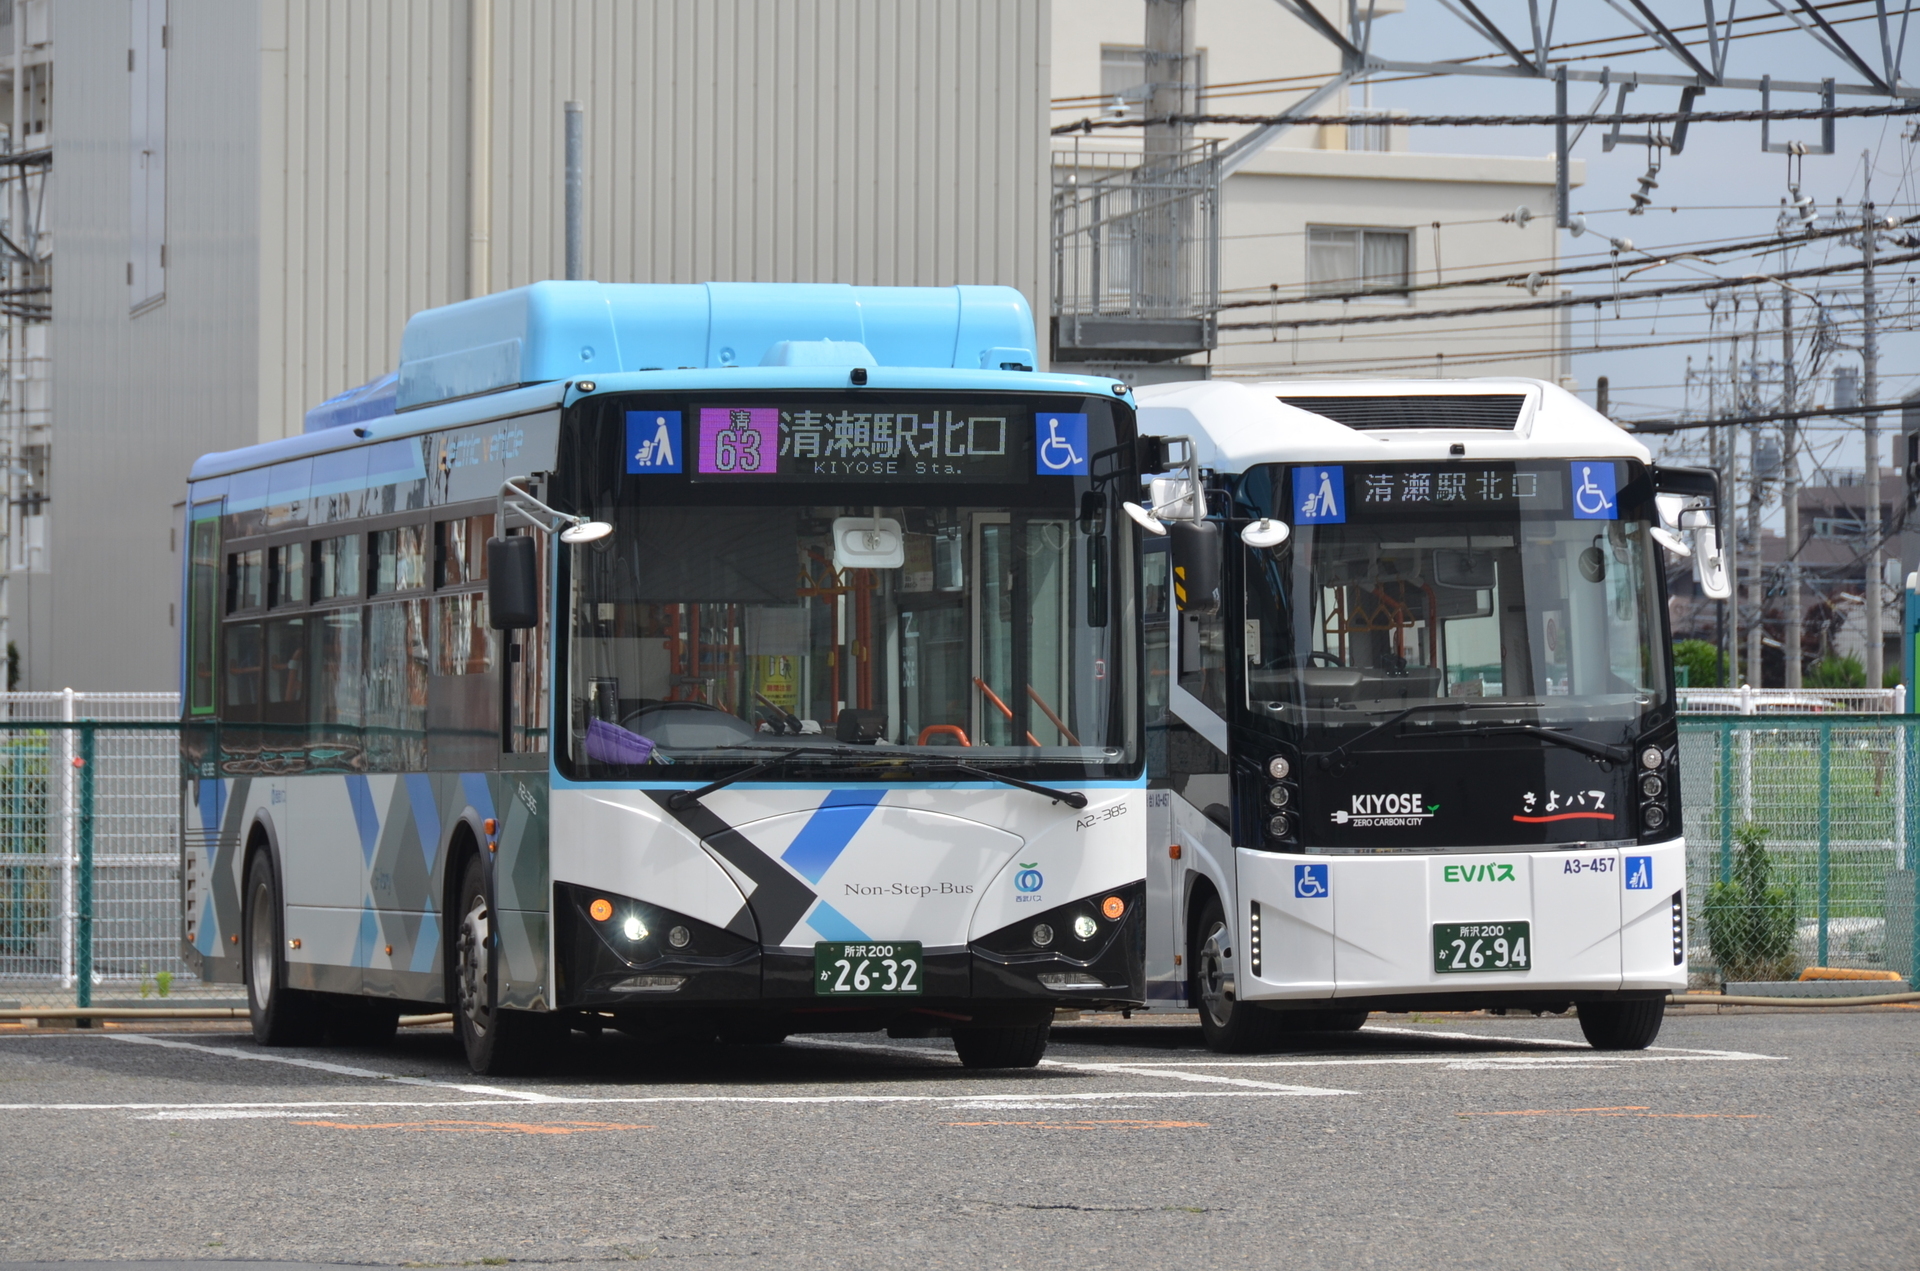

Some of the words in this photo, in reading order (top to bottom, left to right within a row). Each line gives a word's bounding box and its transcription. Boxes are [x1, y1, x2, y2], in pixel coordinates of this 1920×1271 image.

[730, 410, 750, 430] 清
[779, 410, 1007, 458] 清瀬駅北口
[715, 430, 762, 471] 63
[814, 461, 898, 474] KIYOSE
[915, 461, 962, 474] Sta.
[1365, 471, 1537, 502] 清瀬駅北口
[1352, 793, 1423, 814] KIYOSE
[1523, 790, 1606, 813] きよバス
[1076, 802, 1128, 832] A2-385
[1353, 818, 1373, 827] ZERO
[1374, 818, 1405, 826] CARBON
[1406, 817, 1423, 826] CITY
[1444, 862, 1516, 882] EVバス
[1563, 857, 1616, 875] A3-457
[844, 882, 974, 898] Non-Step-Bus
[1439, 949, 1449, 960] か
[1451, 937, 1527, 969] 26-94
[820, 970, 831, 981] か
[834, 959, 918, 992] 26-32
